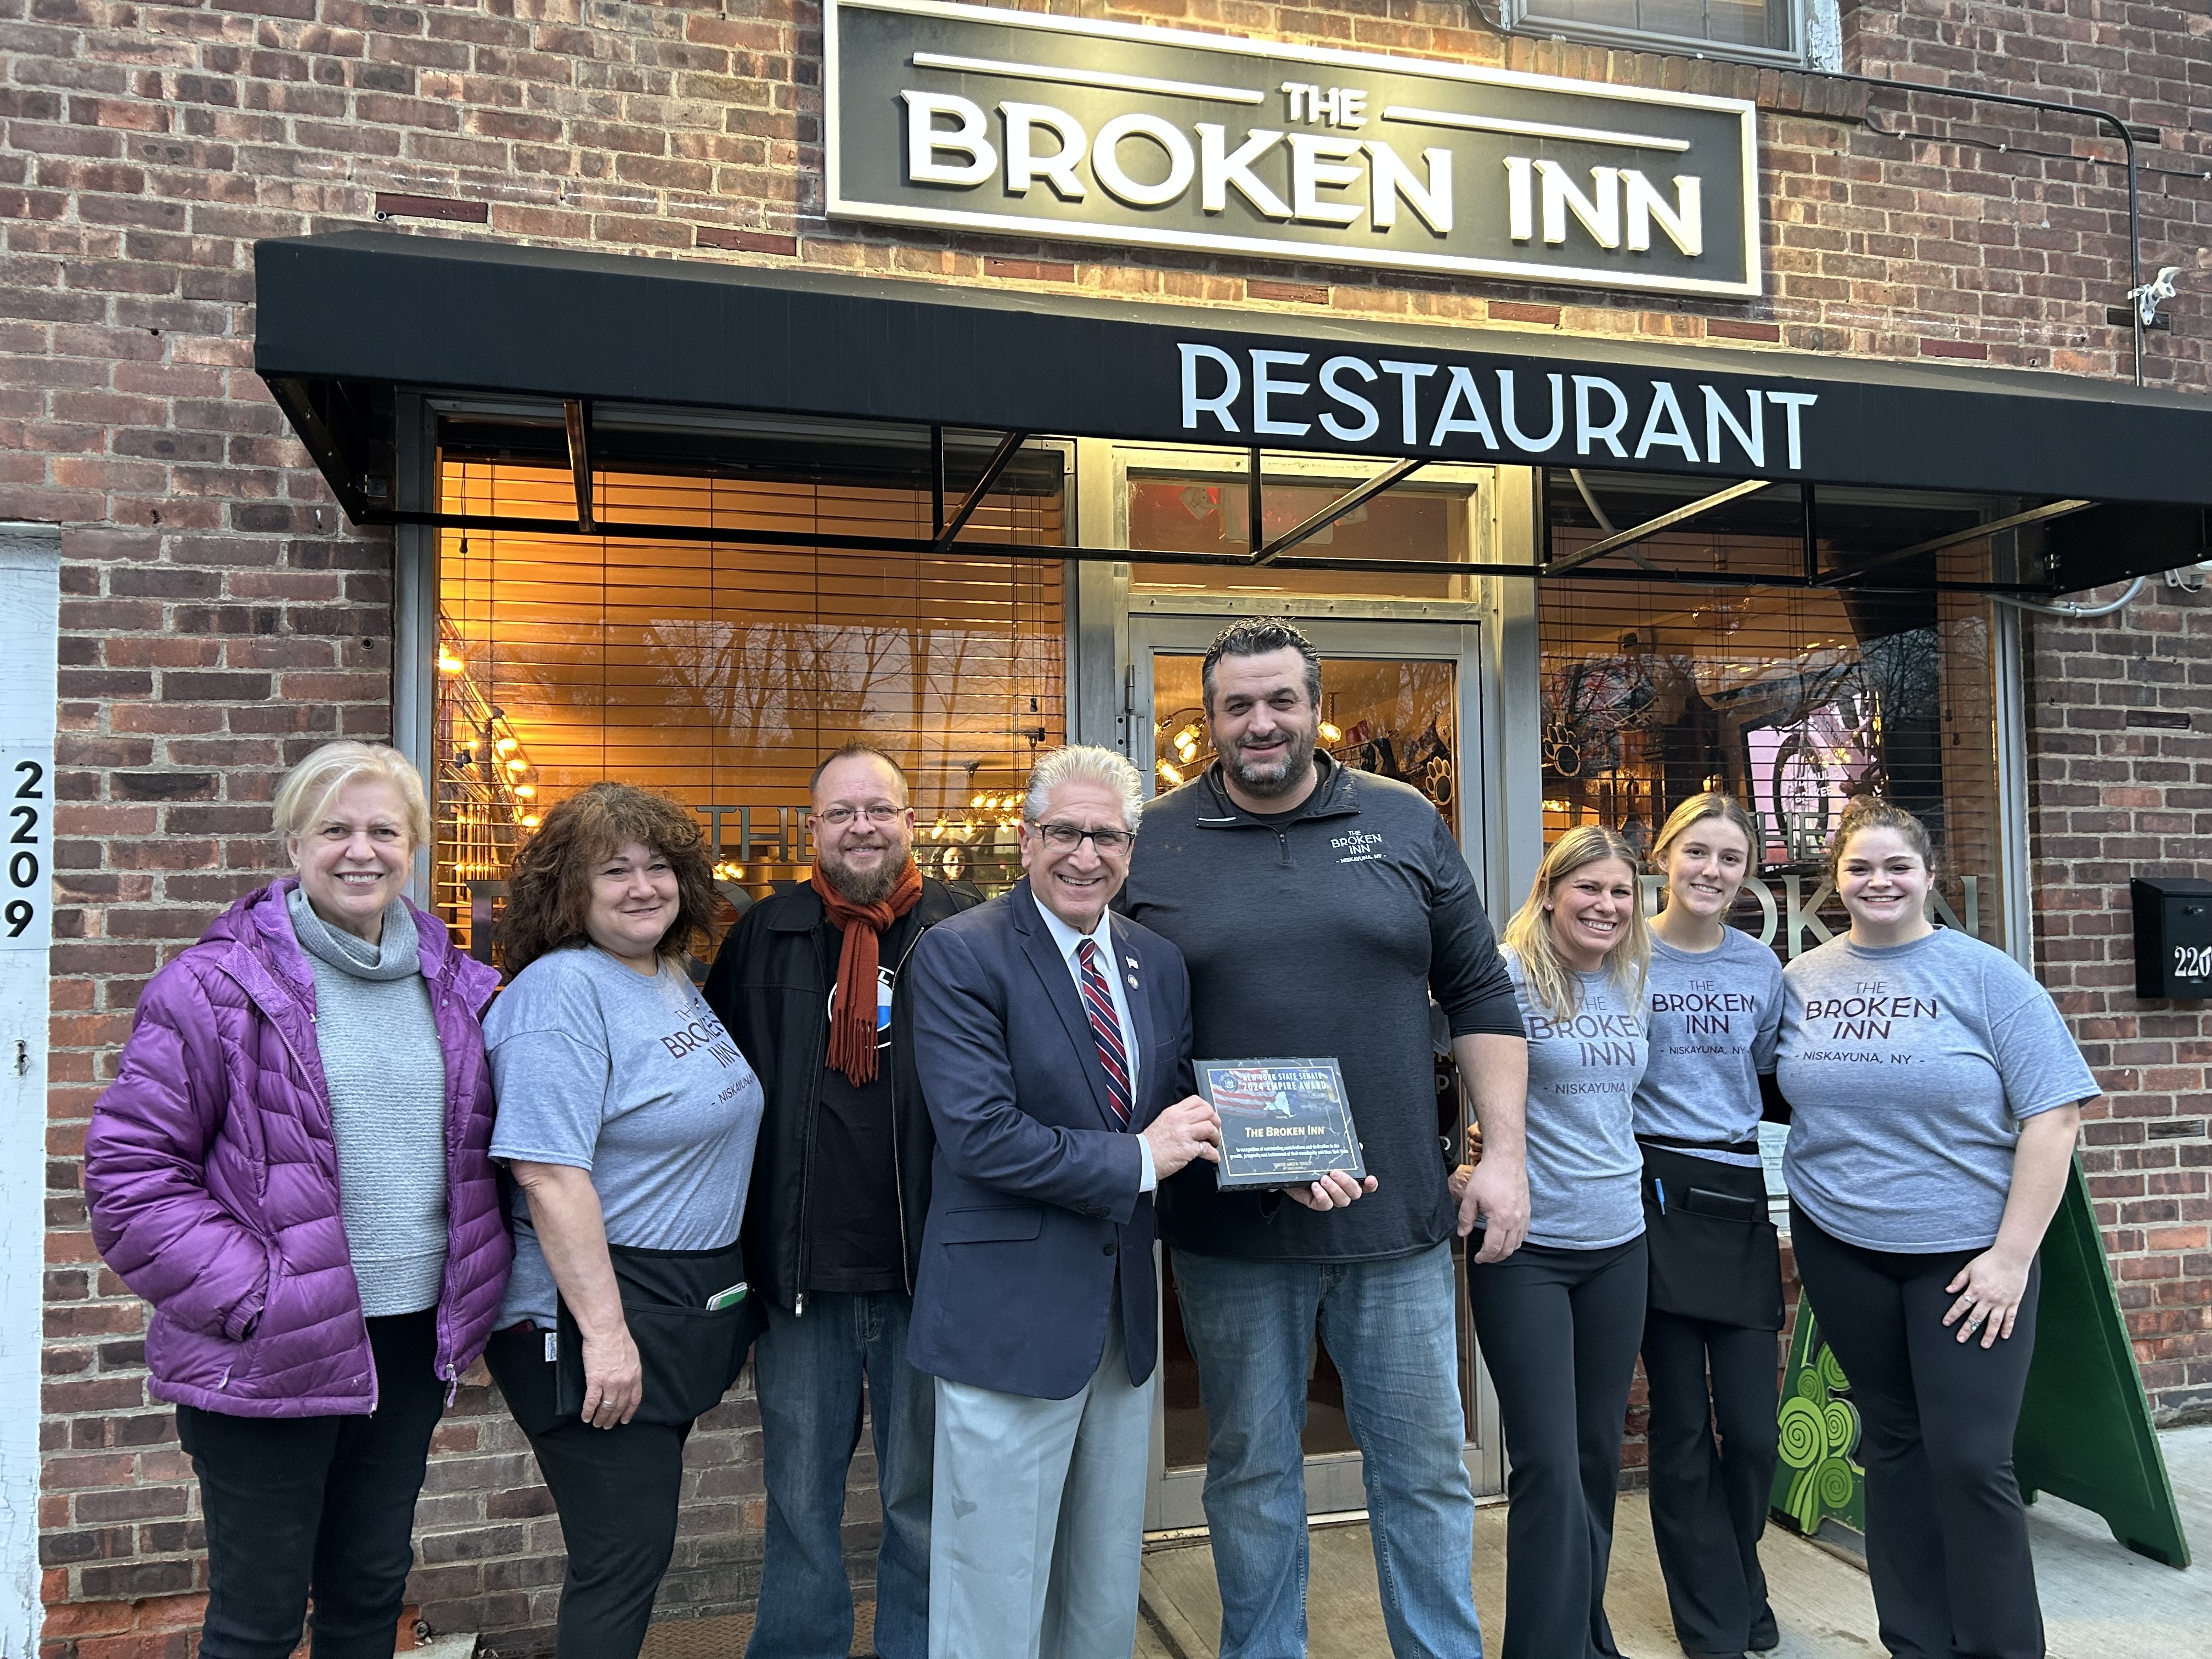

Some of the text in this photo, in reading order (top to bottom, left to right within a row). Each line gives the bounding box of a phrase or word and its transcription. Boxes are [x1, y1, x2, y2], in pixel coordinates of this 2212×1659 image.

[1280, 81, 1368, 128] THE
[900, 89, 1702, 257] BROKEN INN
[1176, 342, 1819, 470] RESTAURANT
[1330, 833, 1383, 848] BROKEN
[1748, 811, 1828, 860] HE
[4, 760, 43, 938] 2209
[1348, 843, 1370, 855] INN
[1688, 980, 1715, 991] THE
[1855, 981, 1888, 994] THE
[1576, 996, 1607, 1011] THE
[1652, 994, 1754, 1013] BROKEN
[1805, 997, 1937, 1020] BROKEN
[1686, 1015, 1729, 1034] INN
[1832, 1020, 1891, 1040] INN
[707, 1040, 741, 1068] INN
[1578, 1042, 1636, 1066] INN
[1803, 1051, 1912, 1064] NISKAYUNA, NY
[1242, 1081, 1327, 1091] 2024 EMPIRE AWARD
[1245, 1125, 1324, 1137] THE BROKEN INN
